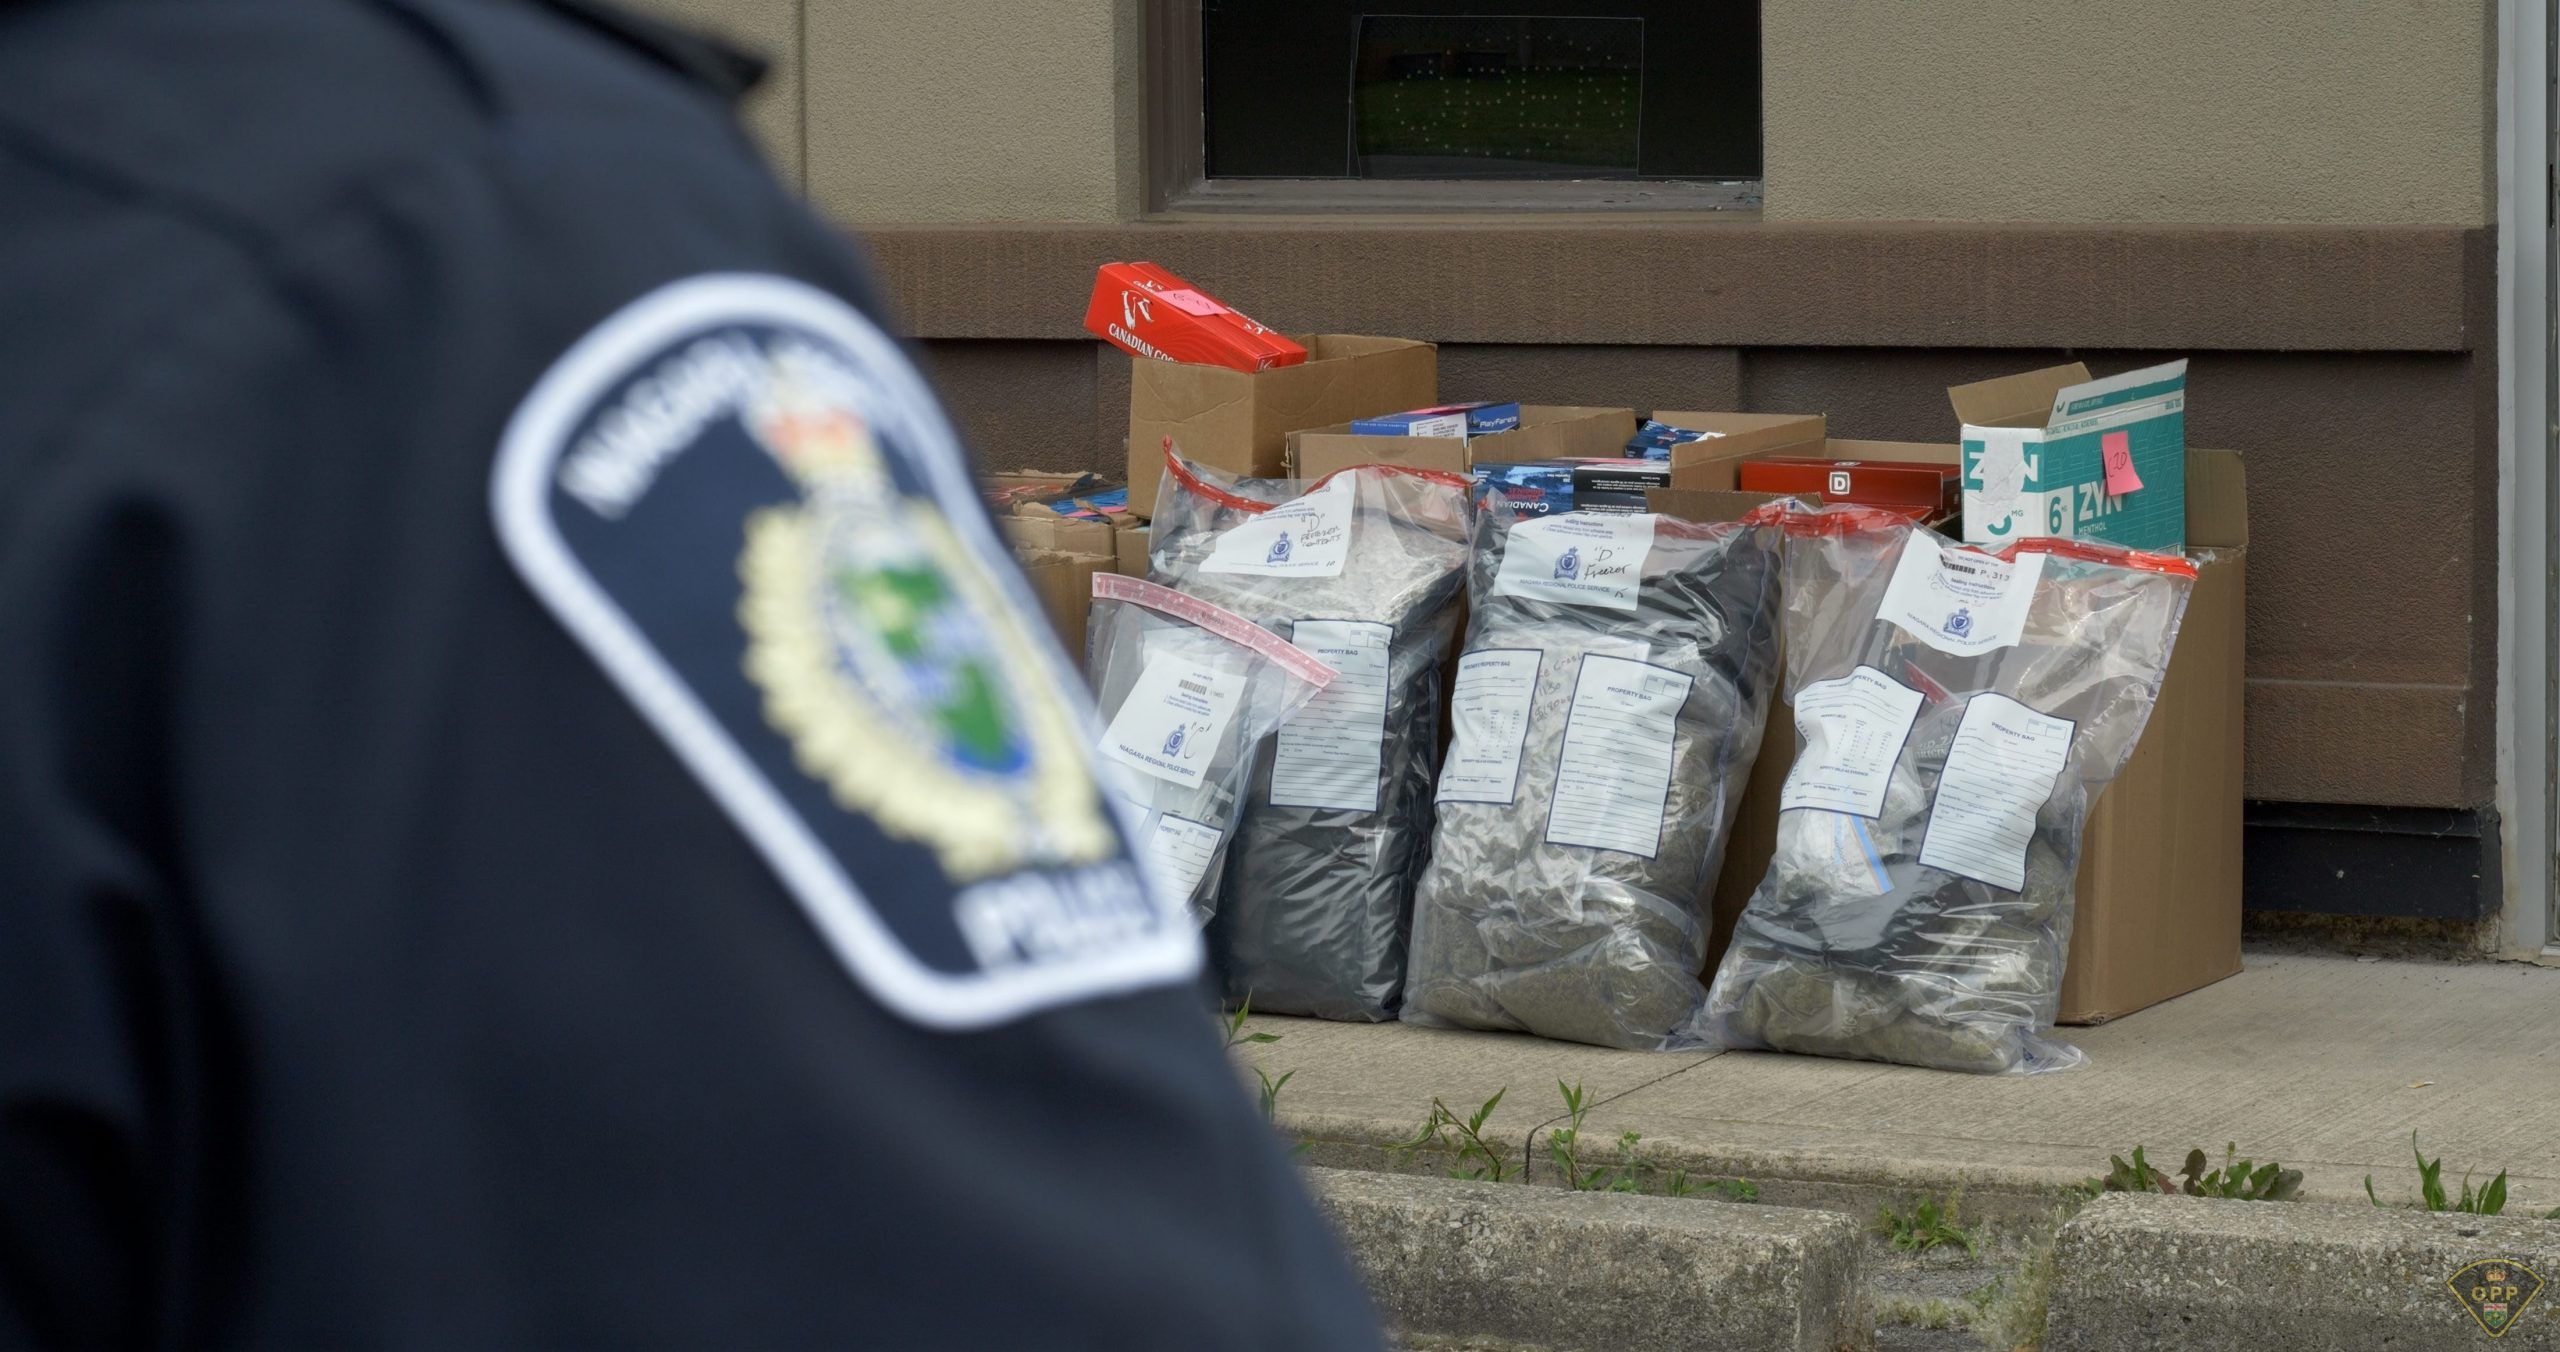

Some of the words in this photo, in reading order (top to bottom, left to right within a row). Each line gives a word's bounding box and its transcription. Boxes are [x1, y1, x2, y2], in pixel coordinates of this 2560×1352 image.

[1108, 322, 1153, 359] CANADIAN
[1969, 451, 2038, 483] ZN
[1834, 477, 1846, 490] D
[2078, 480, 2124, 522] ZYN
[2012, 509, 2024, 517] MG
[2049, 495, 2062, 535] 6
[2078, 521, 2107, 536] MENTHOL
[1567, 582, 1586, 590] POLICE
[1607, 686, 1638, 699] PROPERTY
[1638, 692, 1652, 701] BAG
[1991, 721, 2021, 739] PROPERTY
[2020, 734, 2036, 743] BAG
[1118, 743, 1145, 762] NIAGARA
[1145, 755, 1168, 770] REGIONAL
